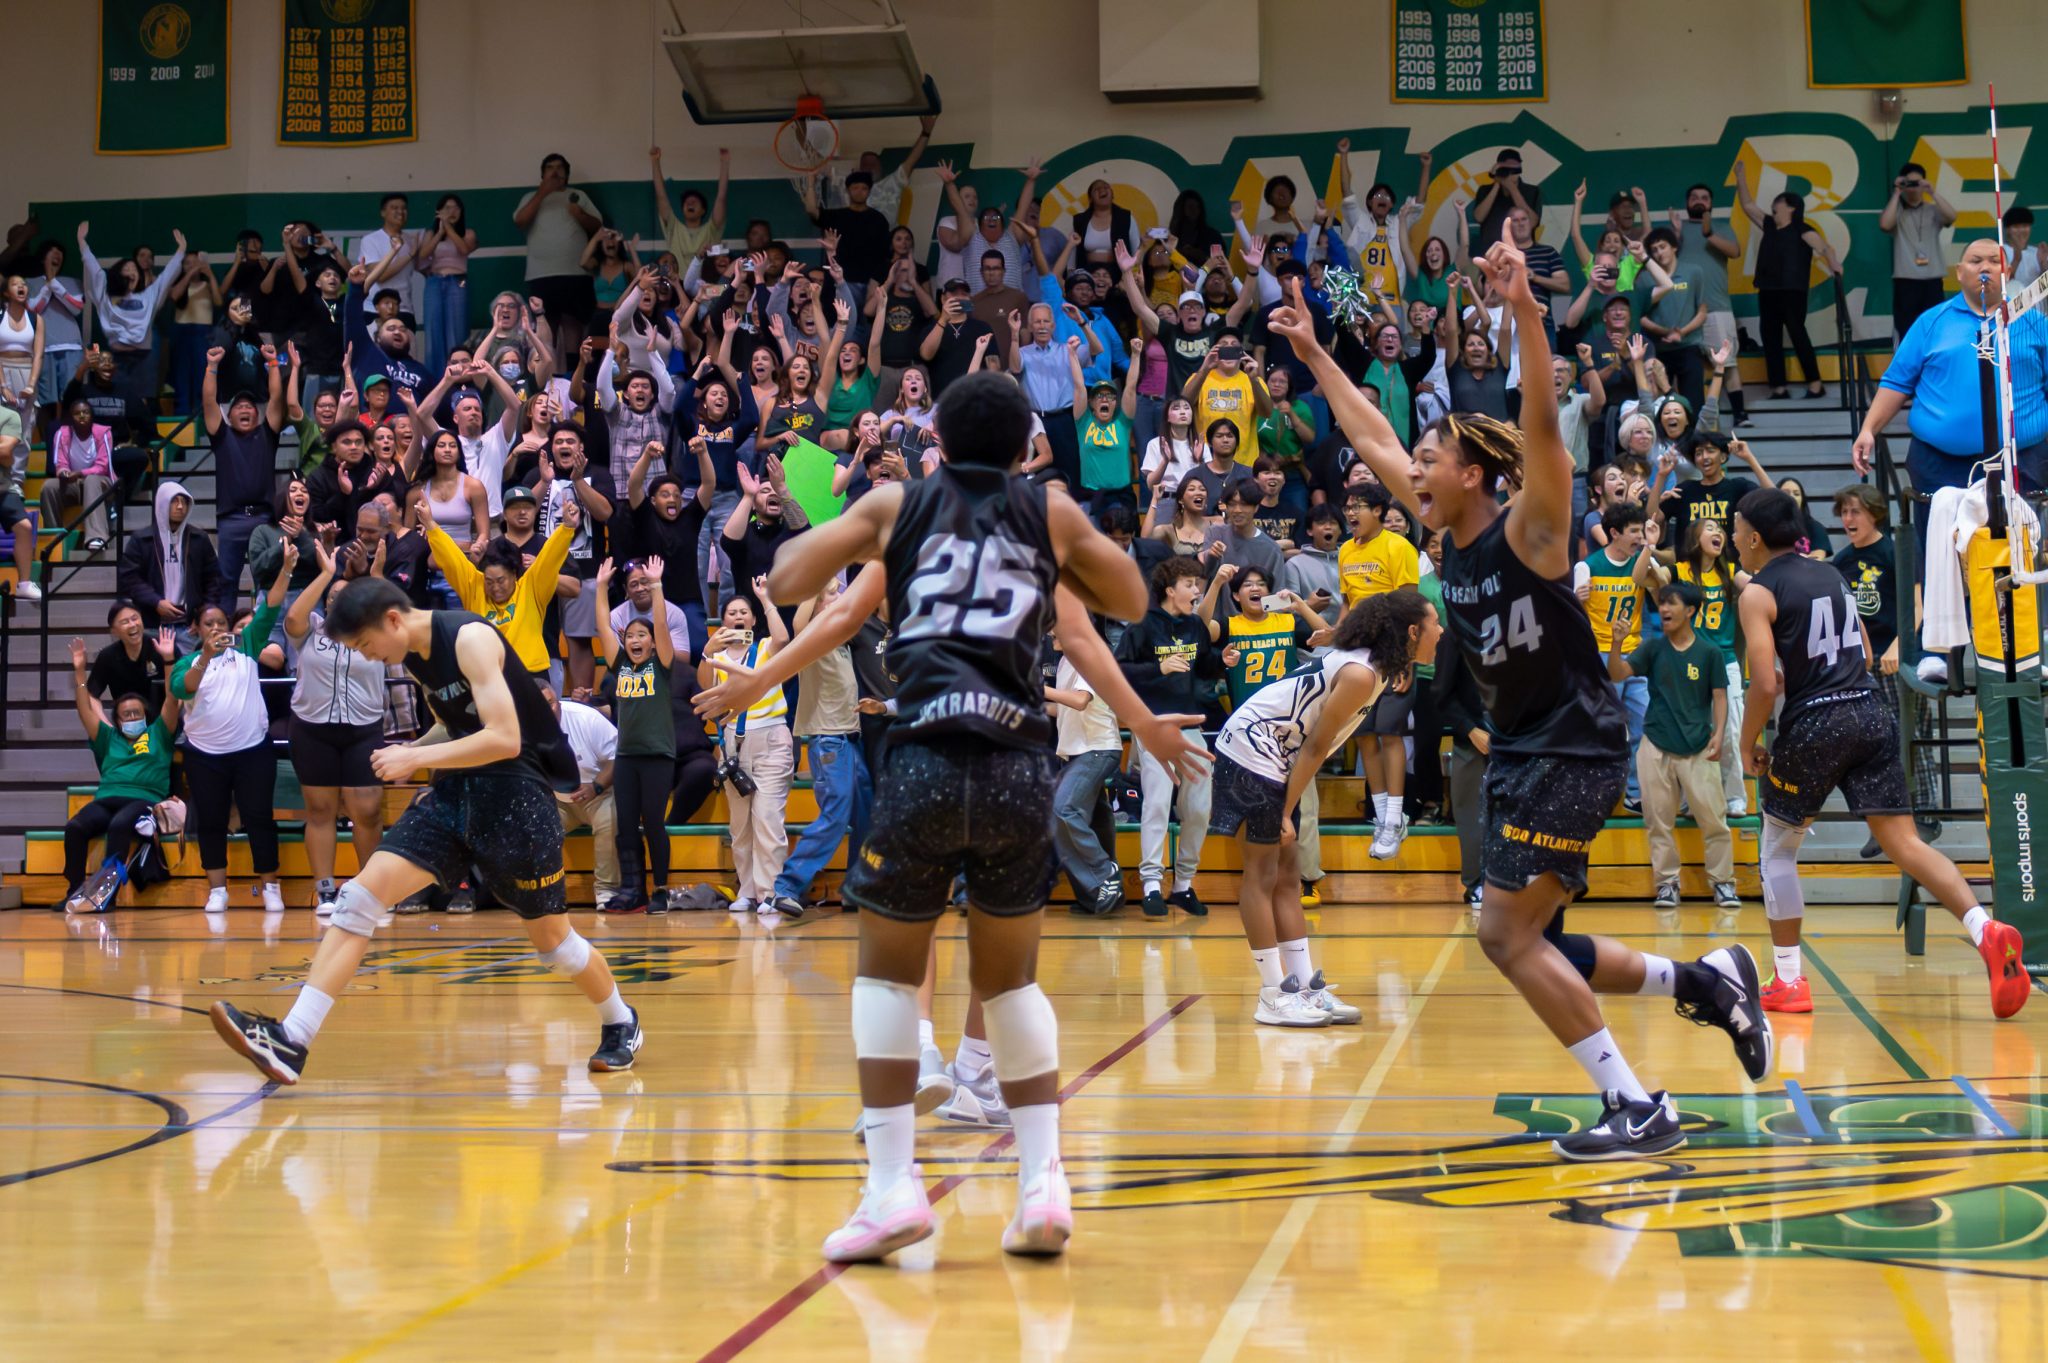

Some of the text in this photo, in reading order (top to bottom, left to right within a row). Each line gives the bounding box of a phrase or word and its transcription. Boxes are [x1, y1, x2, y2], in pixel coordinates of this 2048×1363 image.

[1400, 11, 1534, 27] 1993 1994 1995
[290, 28, 320, 41] 1977
[372, 26, 405, 40] 1979
[1400, 28, 1534, 42] 1996 1998 1999
[1399, 44, 1535, 59] 2000 2004 2005
[110, 67, 136, 81] 1999
[151, 66, 180, 80] 2008
[1399, 60, 1536, 75] 2006 2007 2008
[1399, 77, 1533, 91] 2009 2010 2011
[288, 87, 406, 102] 2001 2002 2003
[287, 103, 406, 118] 2004 2005 2007
[287, 118, 405, 133] 2008 2009 2010
[1367, 247, 1386, 266] 81
[1085, 421, 1120, 447] POLY
[1690, 500, 1729, 521] POLY
[898, 532, 1038, 640] 25
[1605, 595, 1636, 623] 18
[1480, 593, 1543, 666] 24
[1807, 594, 1867, 667] 44
[1245, 650, 1287, 684] 24
[1532, 831, 1583, 853] ATLANTIC
[2013, 793, 2035, 902] sports imports
